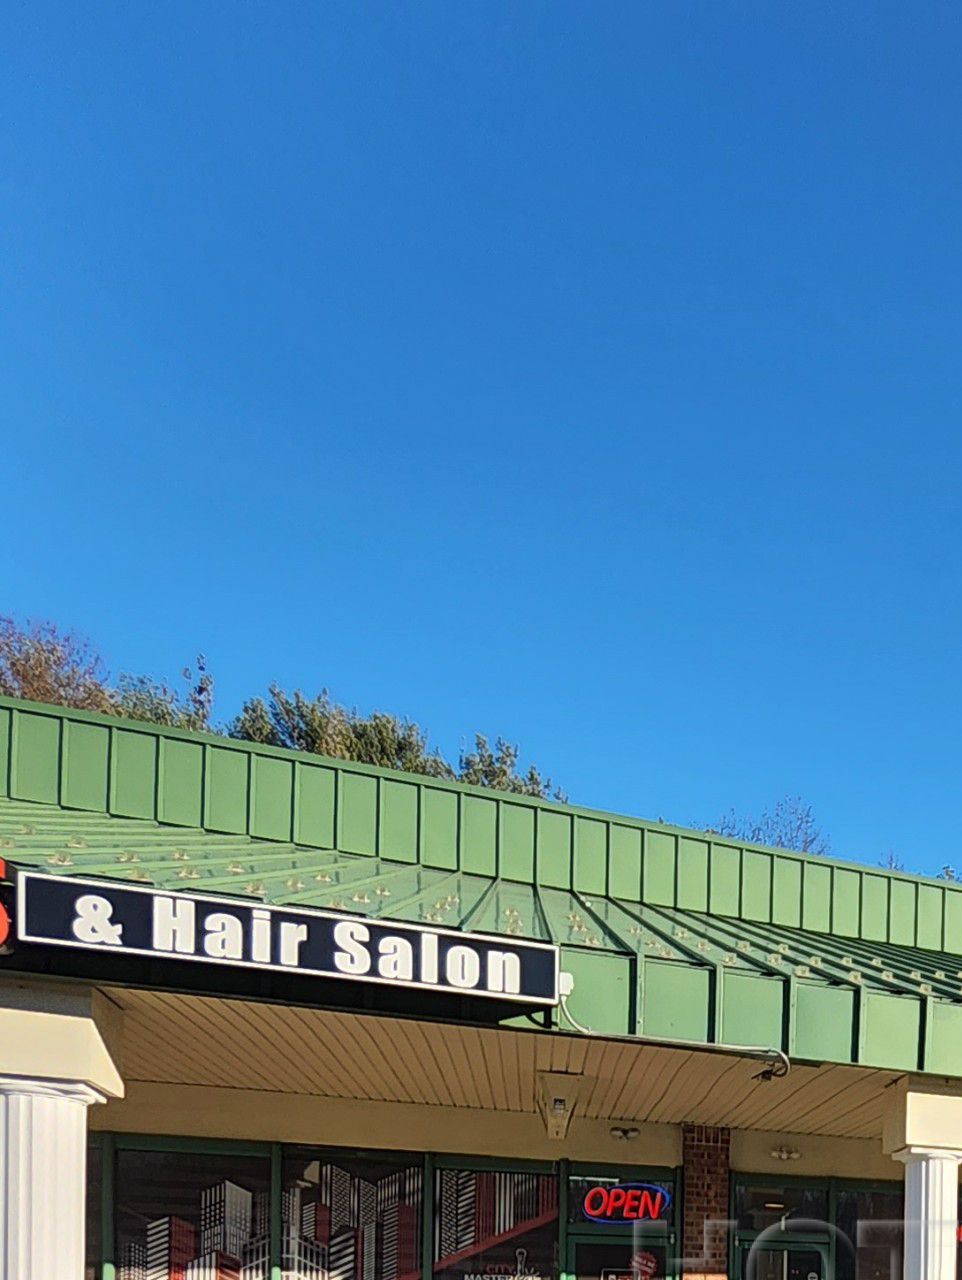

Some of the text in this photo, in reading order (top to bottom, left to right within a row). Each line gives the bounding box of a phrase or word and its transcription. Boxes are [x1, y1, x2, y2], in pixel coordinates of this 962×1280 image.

[72, 894, 123, 946] &
[152, 896, 308, 967] Hair
[333, 921, 522, 995] Salon
[584, 1186, 662, 1219] OPEN
[486, 1263, 514, 1274] CITY
